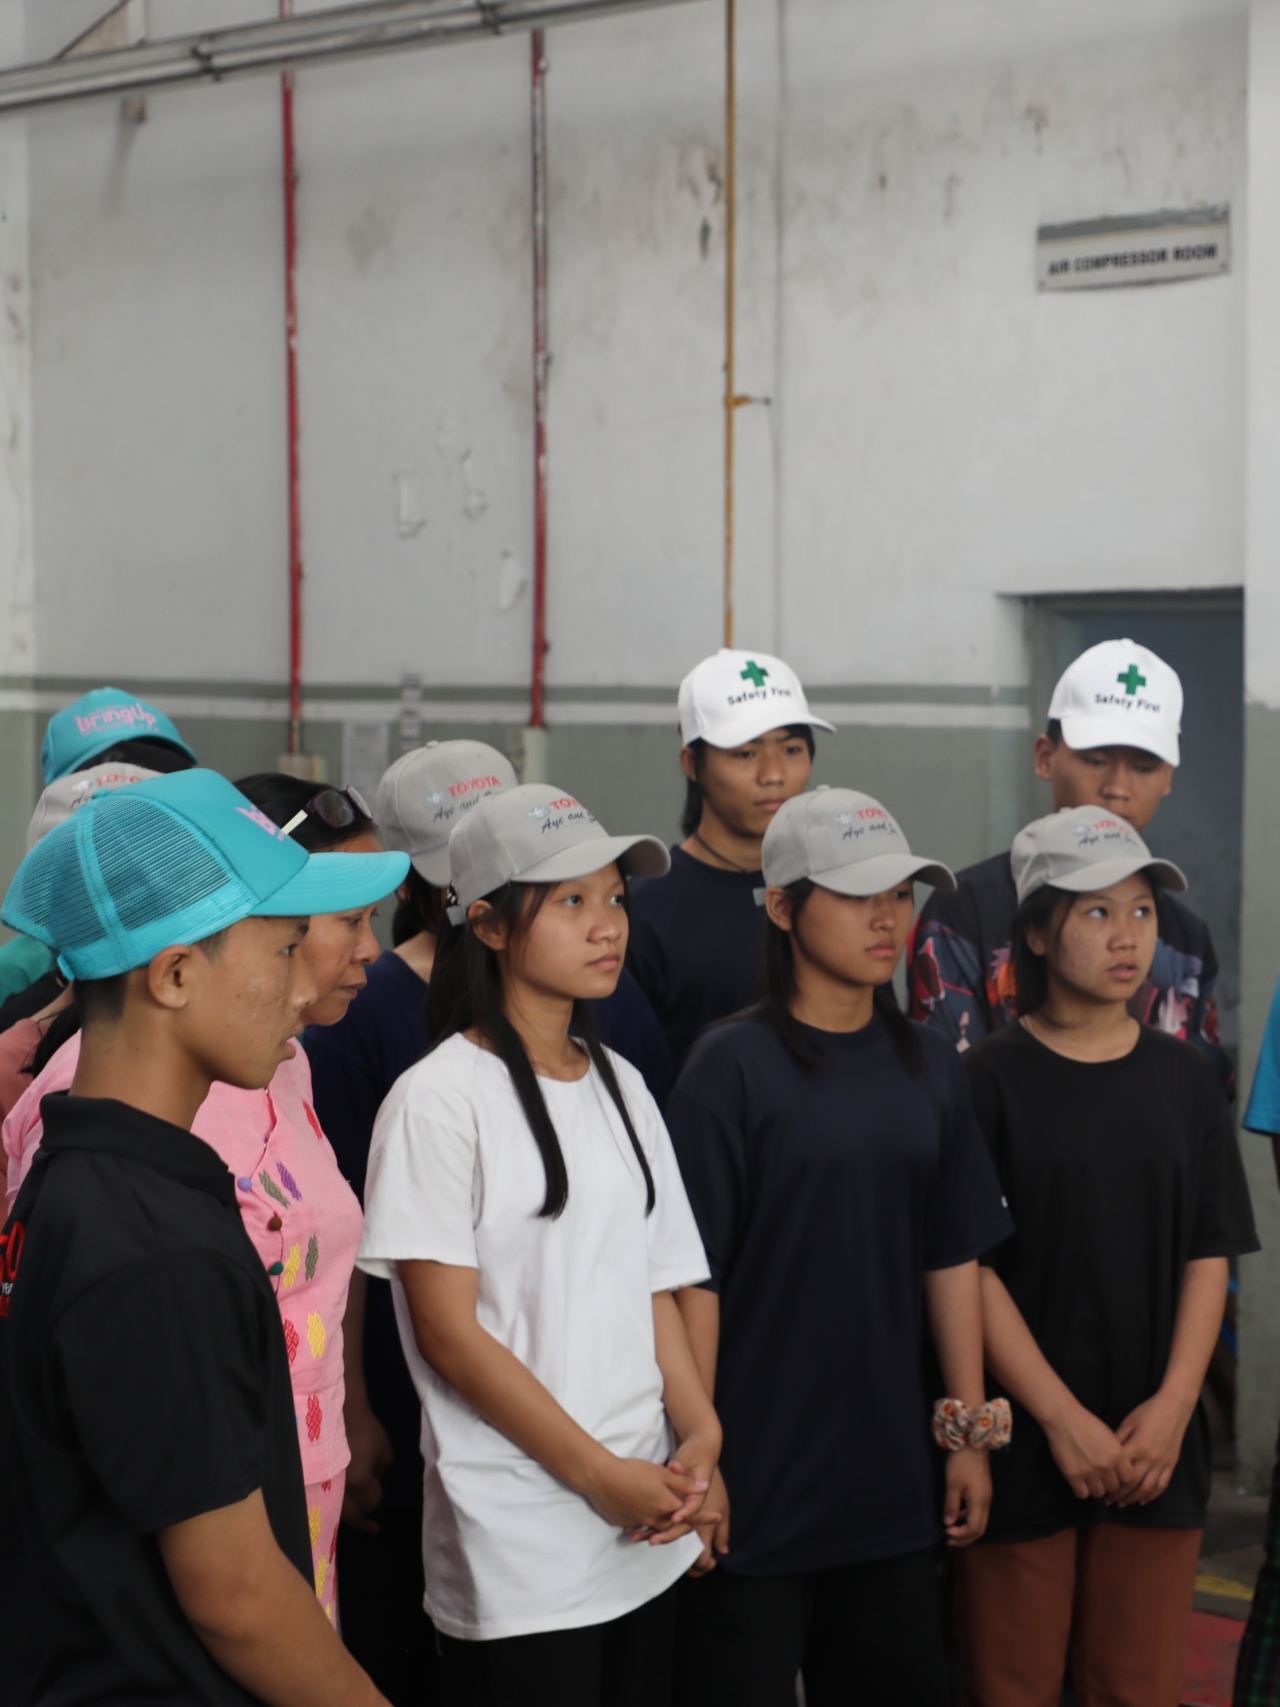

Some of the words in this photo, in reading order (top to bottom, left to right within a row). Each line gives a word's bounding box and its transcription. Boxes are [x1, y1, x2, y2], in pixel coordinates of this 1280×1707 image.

[1048, 258, 1070, 275] AIR
[1074, 248, 1168, 273] COMPRESSOR
[1173, 242, 1218, 262] ROOM
[727, 689, 767, 706] Safety
[1095, 693, 1132, 710] Safety
[1137, 699, 1161, 713] First
[447, 775, 502, 798] TOYOTA
